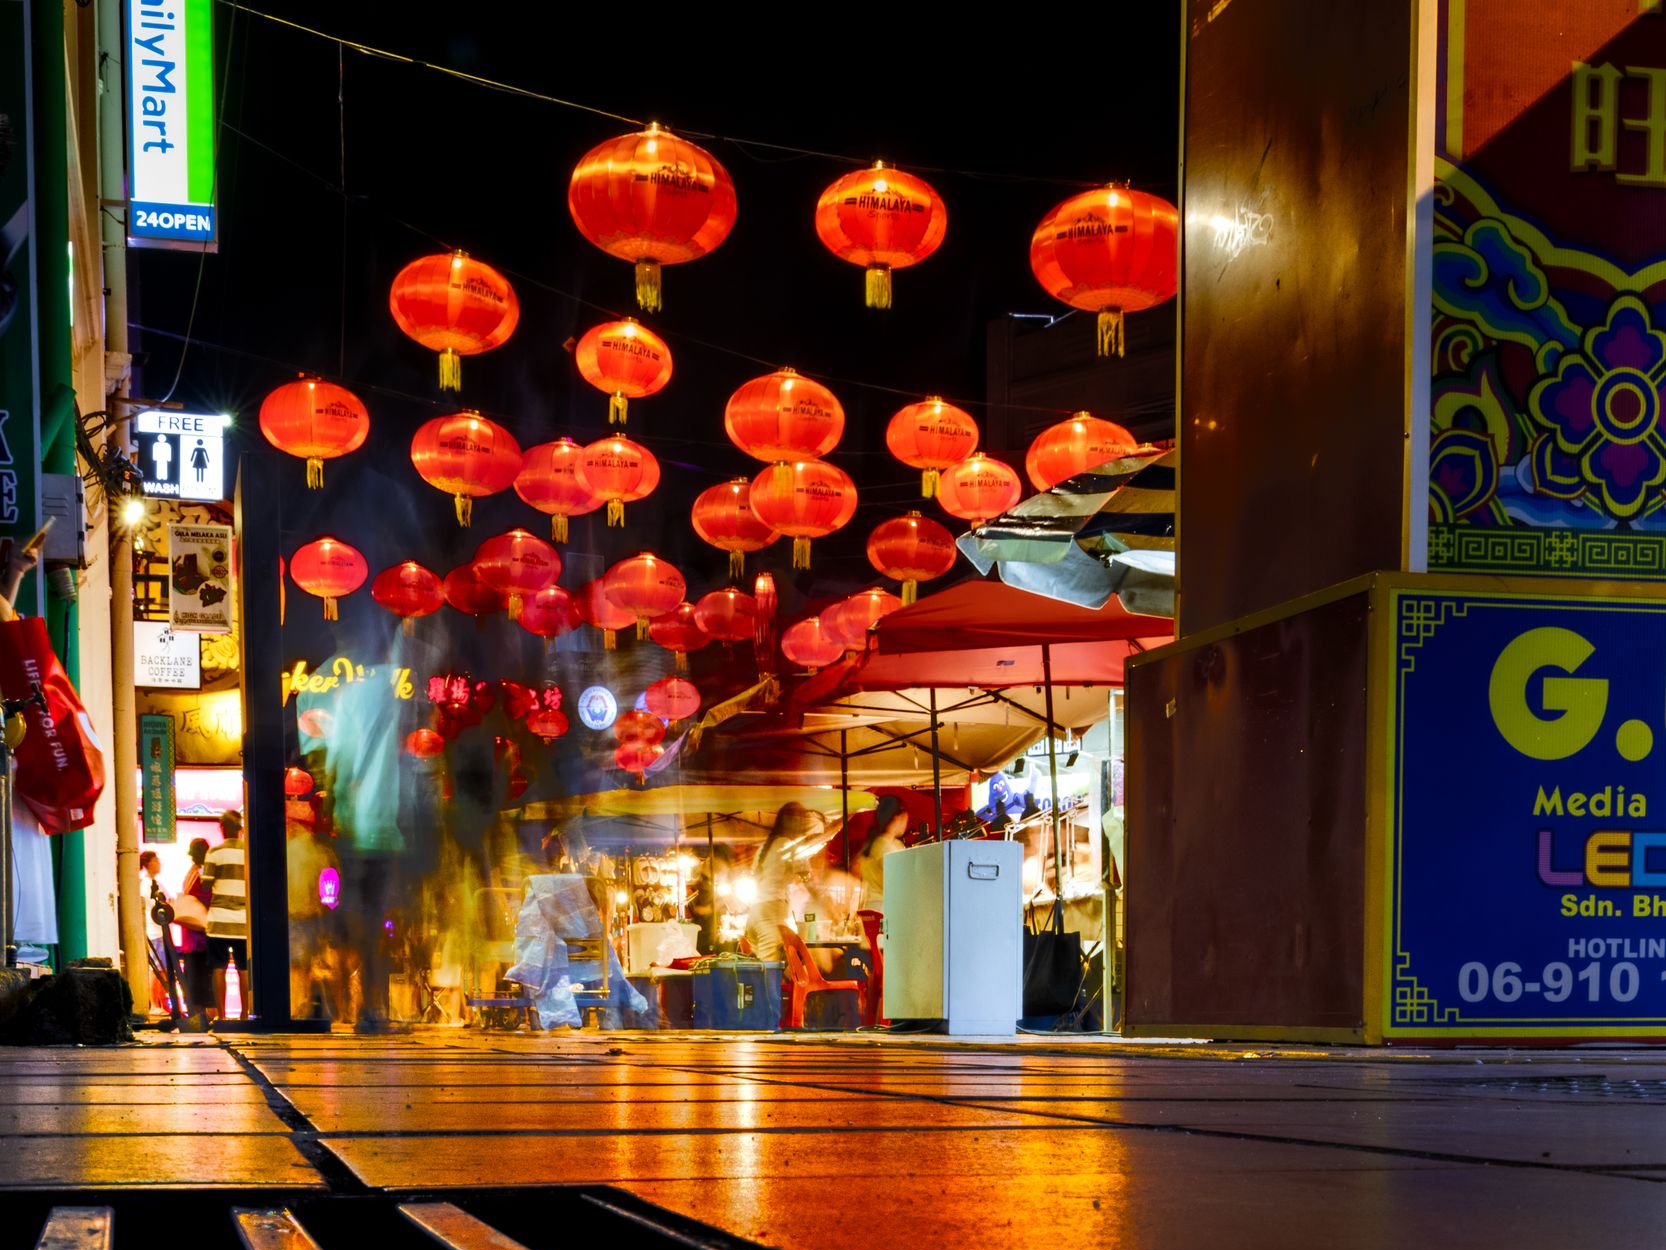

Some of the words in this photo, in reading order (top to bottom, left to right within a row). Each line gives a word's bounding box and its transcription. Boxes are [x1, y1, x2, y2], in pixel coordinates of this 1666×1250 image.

[650, 172, 697, 192] HIMALAYA
[858, 195, 912, 213] HIMALAYA
[136, 210, 211, 231] 24OPEN
[1067, 223, 1114, 240] HIMALAYA
[462, 282, 497, 300] HIMALAYA
[612, 340, 651, 360] HIMALAYA
[324, 407, 353, 418] HIMALAYA
[792, 405, 824, 417] HIMALAYA
[158, 415, 204, 432] FREE
[929, 424, 965, 437] HIMALAYA
[447, 440, 481, 453] HIMALAYA
[594, 459, 629, 469] HIMALAYA
[805, 487, 836, 498] HIMALAYA
[969, 479, 1003, 489] HIMALAYA
[140, 655, 193, 666] BACKLANE
[148, 667, 185, 677] COFFEE
[1488, 626, 1666, 762] G.
[1532, 785, 1648, 818] Media
[1560, 894, 1622, 917] Sdn.
[1568, 937, 1666, 958] HOTLIN
[1457, 961, 1640, 1003] 06-910
